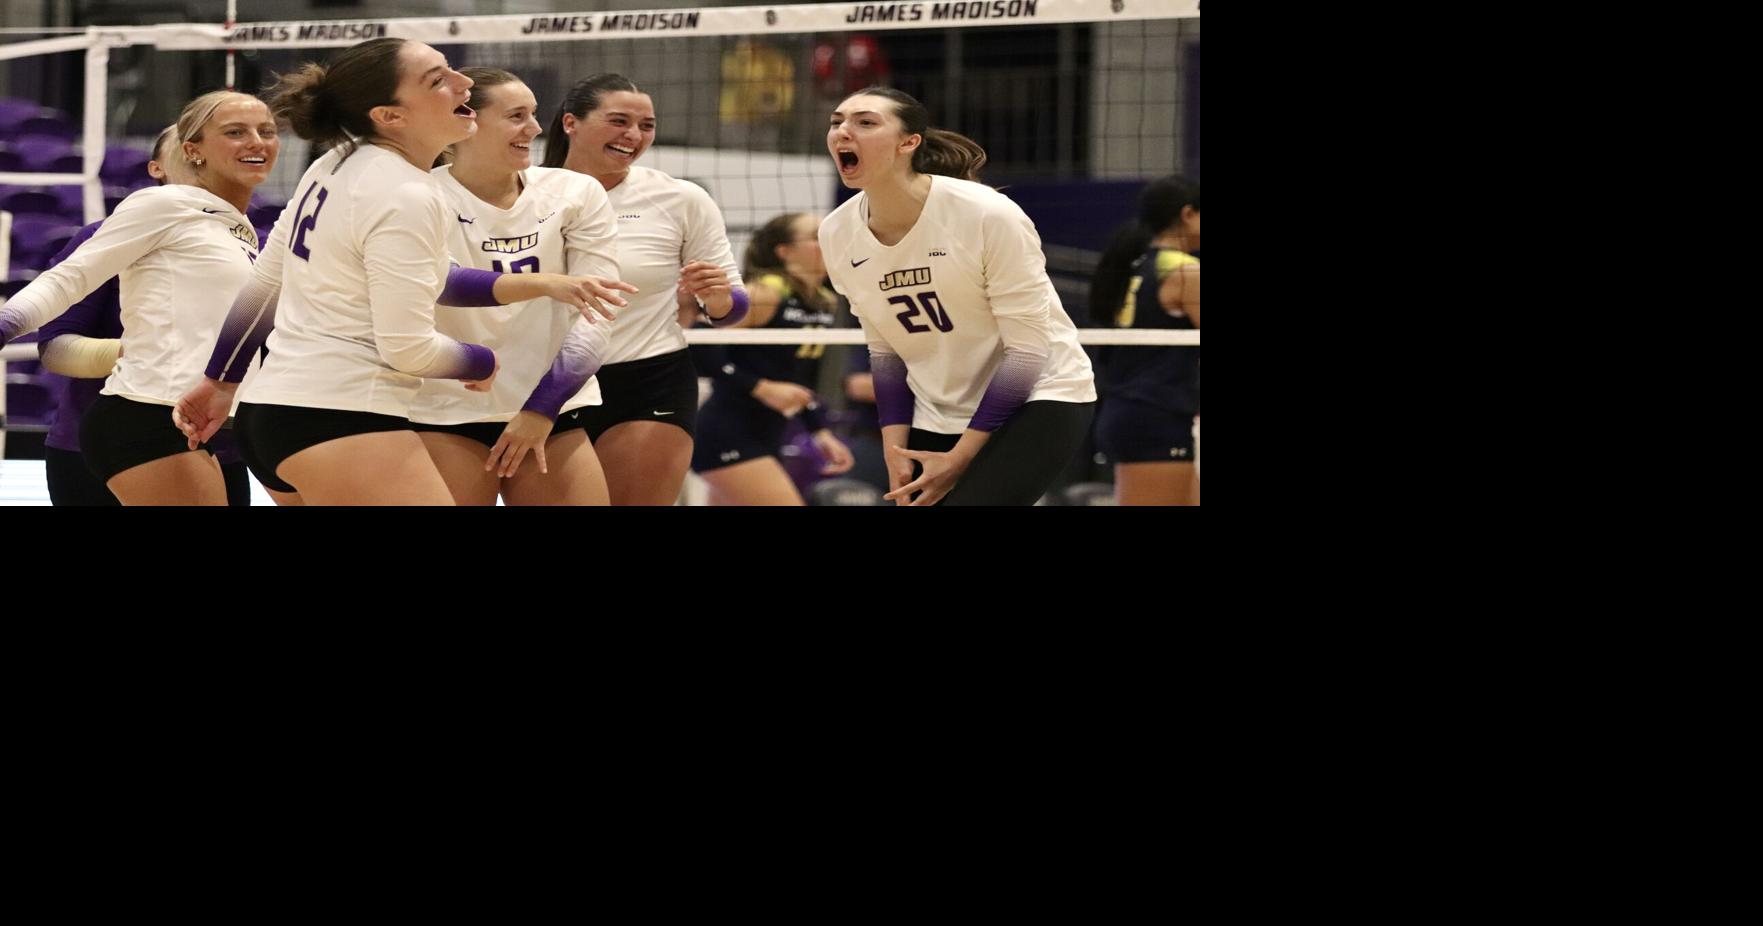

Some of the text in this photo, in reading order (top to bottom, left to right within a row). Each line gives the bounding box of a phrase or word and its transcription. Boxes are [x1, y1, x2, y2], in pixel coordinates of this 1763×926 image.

[522, 11, 700, 34] JAMES MADISON
[847, 0, 1037, 23] JAMES MADISON
[297, 22, 387, 41] MADISON
[287, 180, 329, 262] 12
[481, 231, 539, 254] JMU
[878, 266, 932, 291] JMU
[887, 291, 954, 334] 20
